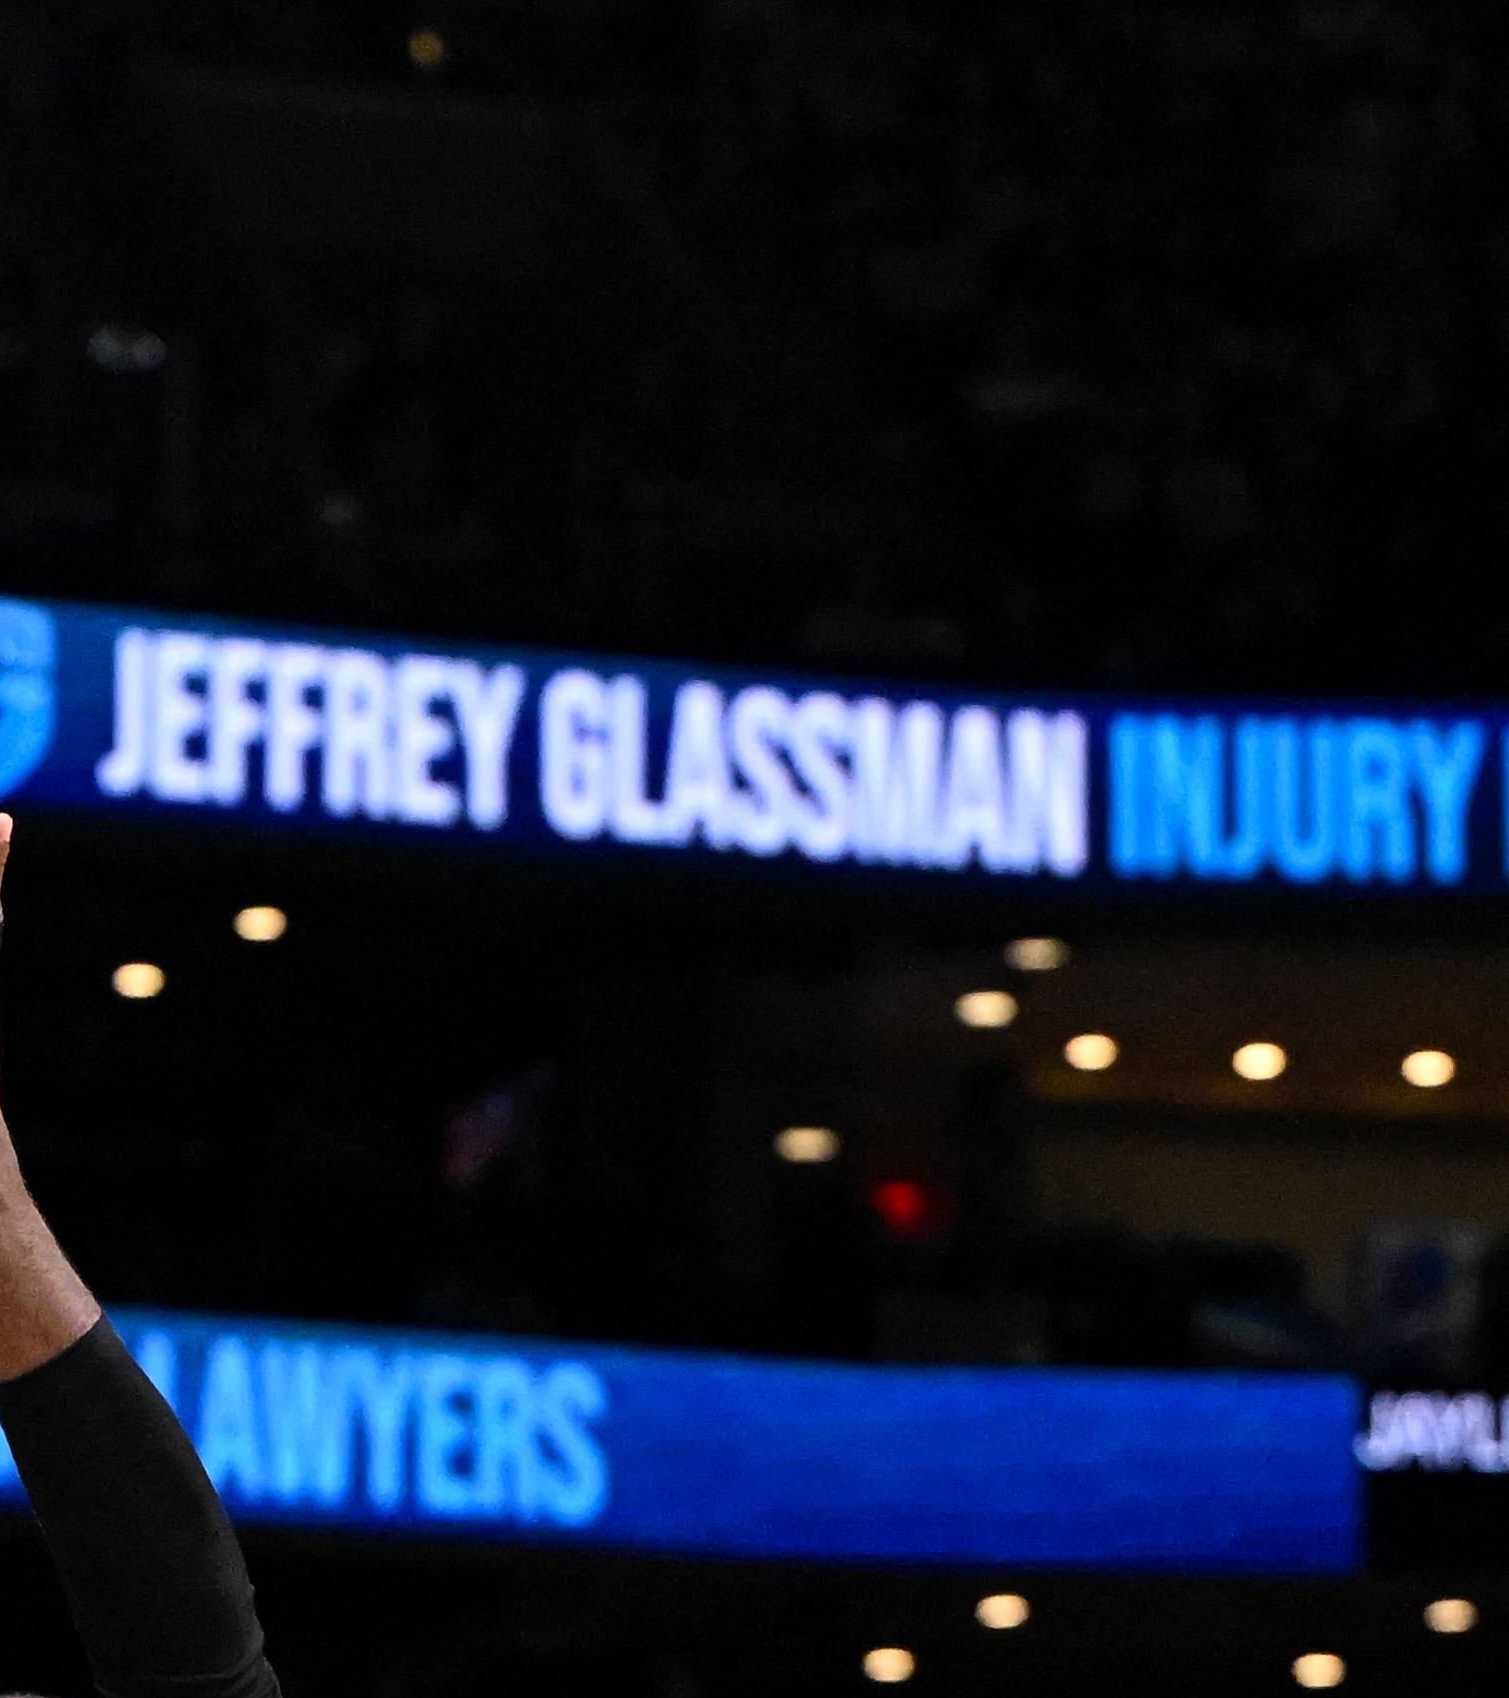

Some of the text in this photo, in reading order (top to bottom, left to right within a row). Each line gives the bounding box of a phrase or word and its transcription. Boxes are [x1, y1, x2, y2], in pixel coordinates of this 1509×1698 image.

[92, 624, 527, 831] JEFFREY
[537, 666, 1091, 880] GLASSMAN
[1107, 711, 1485, 884] INJURY
[1353, 1390, 1509, 1472] JAYL
